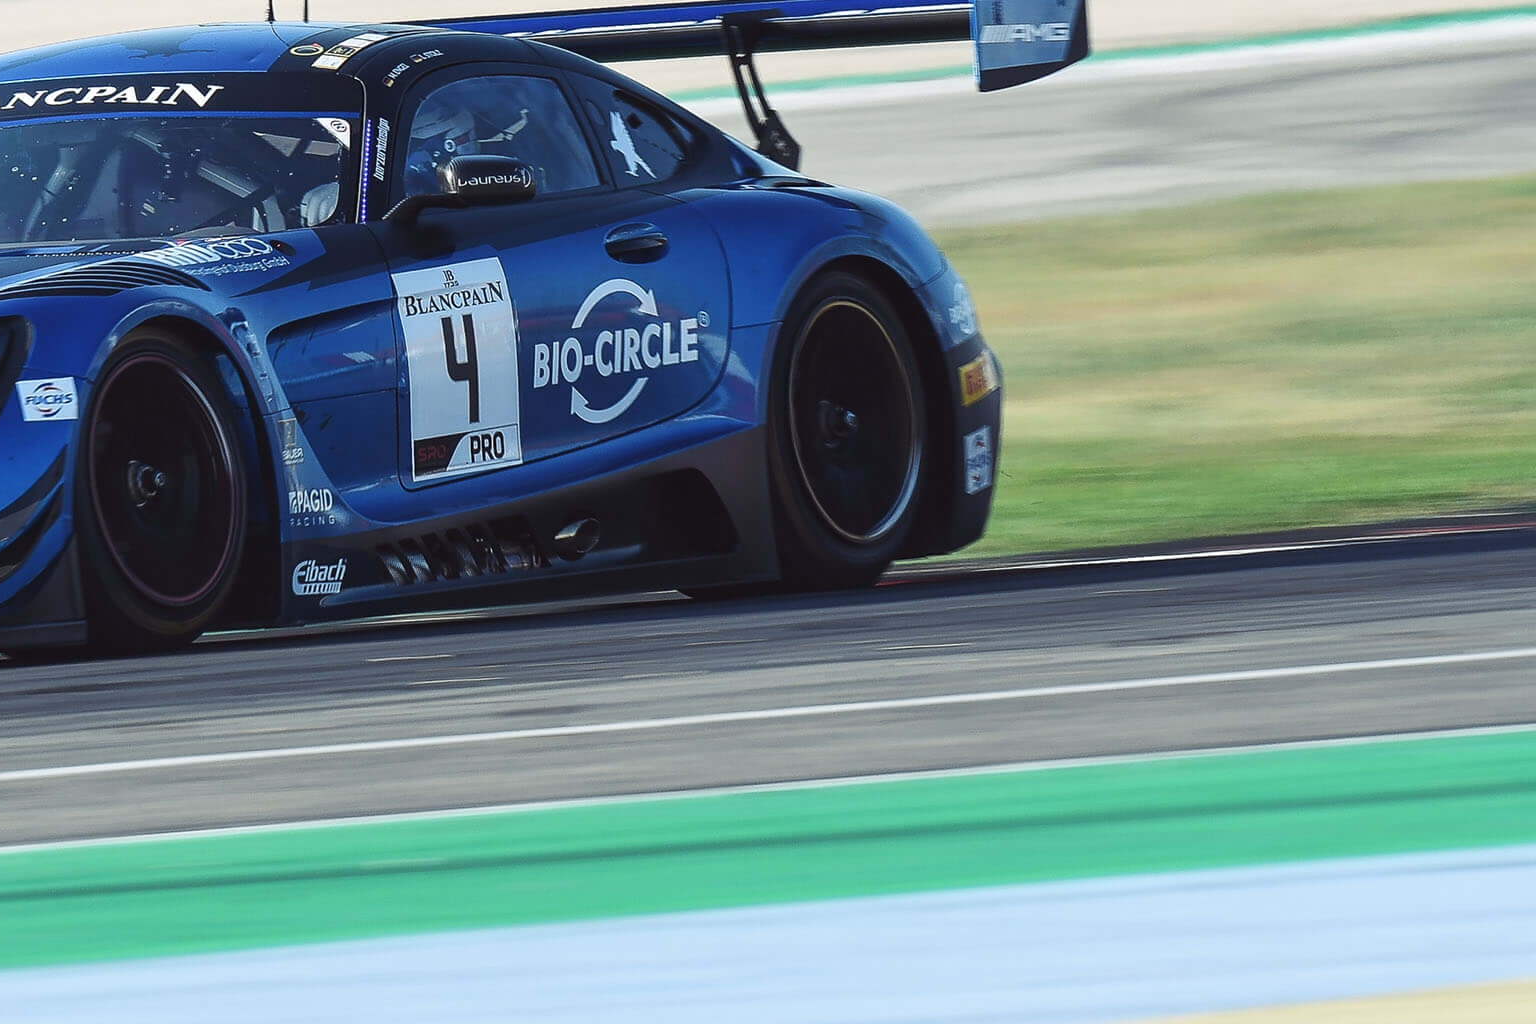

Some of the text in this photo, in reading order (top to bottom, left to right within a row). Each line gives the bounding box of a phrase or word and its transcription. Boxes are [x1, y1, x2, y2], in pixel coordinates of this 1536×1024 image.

[404, 280, 504, 317] BLANCPAIN
[440, 314, 480, 424] 4
[25, 392, 73, 406] FUCHS
[469, 431, 505, 464] PRO
[296, 488, 333, 514] PAGID
[292, 558, 347, 596] Eibach
